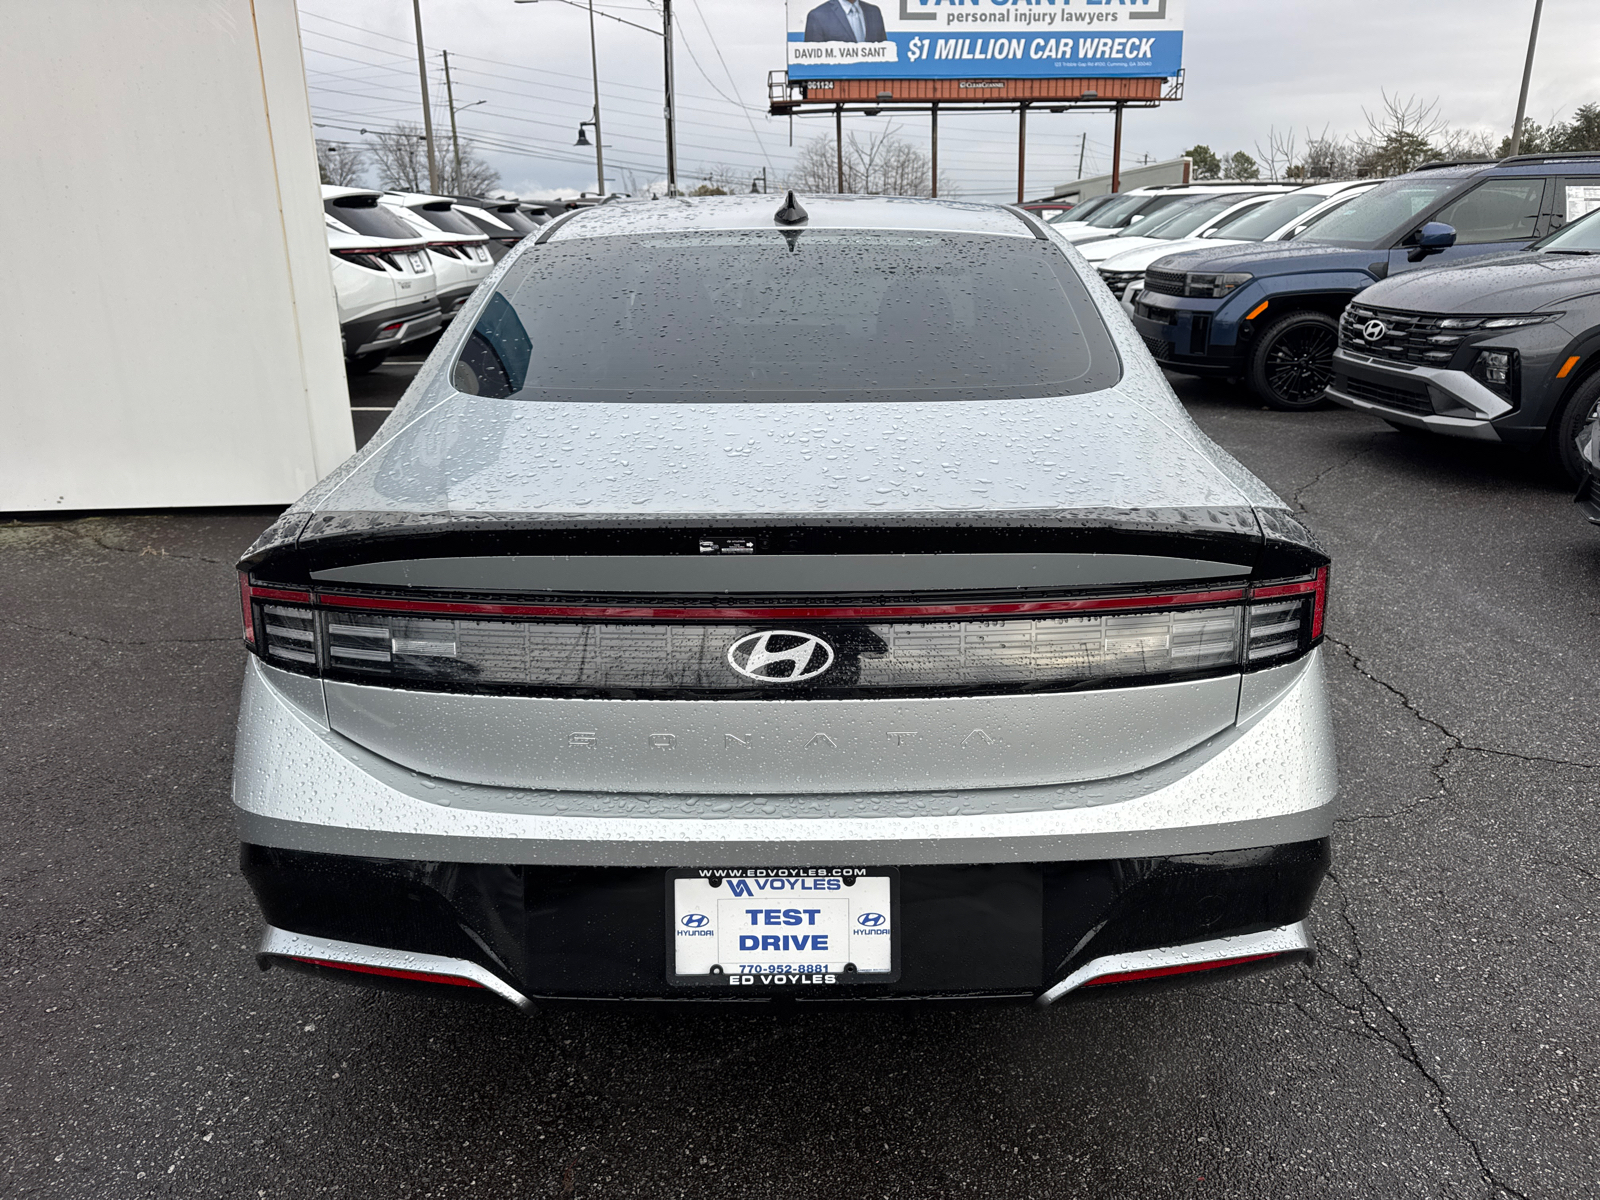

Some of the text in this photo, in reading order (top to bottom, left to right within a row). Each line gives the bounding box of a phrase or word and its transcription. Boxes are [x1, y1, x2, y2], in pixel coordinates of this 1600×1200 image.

[947, 8, 1118, 26] personal injury lawyers
[794, 47, 887, 59] DAVID M. VAN SANT
[907, 36, 1156, 62] $1 MILLION CAR WRECK
[567, 729, 995, 750] SONATA
[698, 868, 867, 877] WWW.EDVOYLES.COM
[754, 878, 841, 890] VOYLES
[745, 909, 821, 926] TEST
[853, 928, 890, 936] HYUNDAI
[739, 935, 829, 951] DRIVE
[739, 964, 829, 974] 770-952-8881
[729, 975, 837, 985] ED VOYLES
